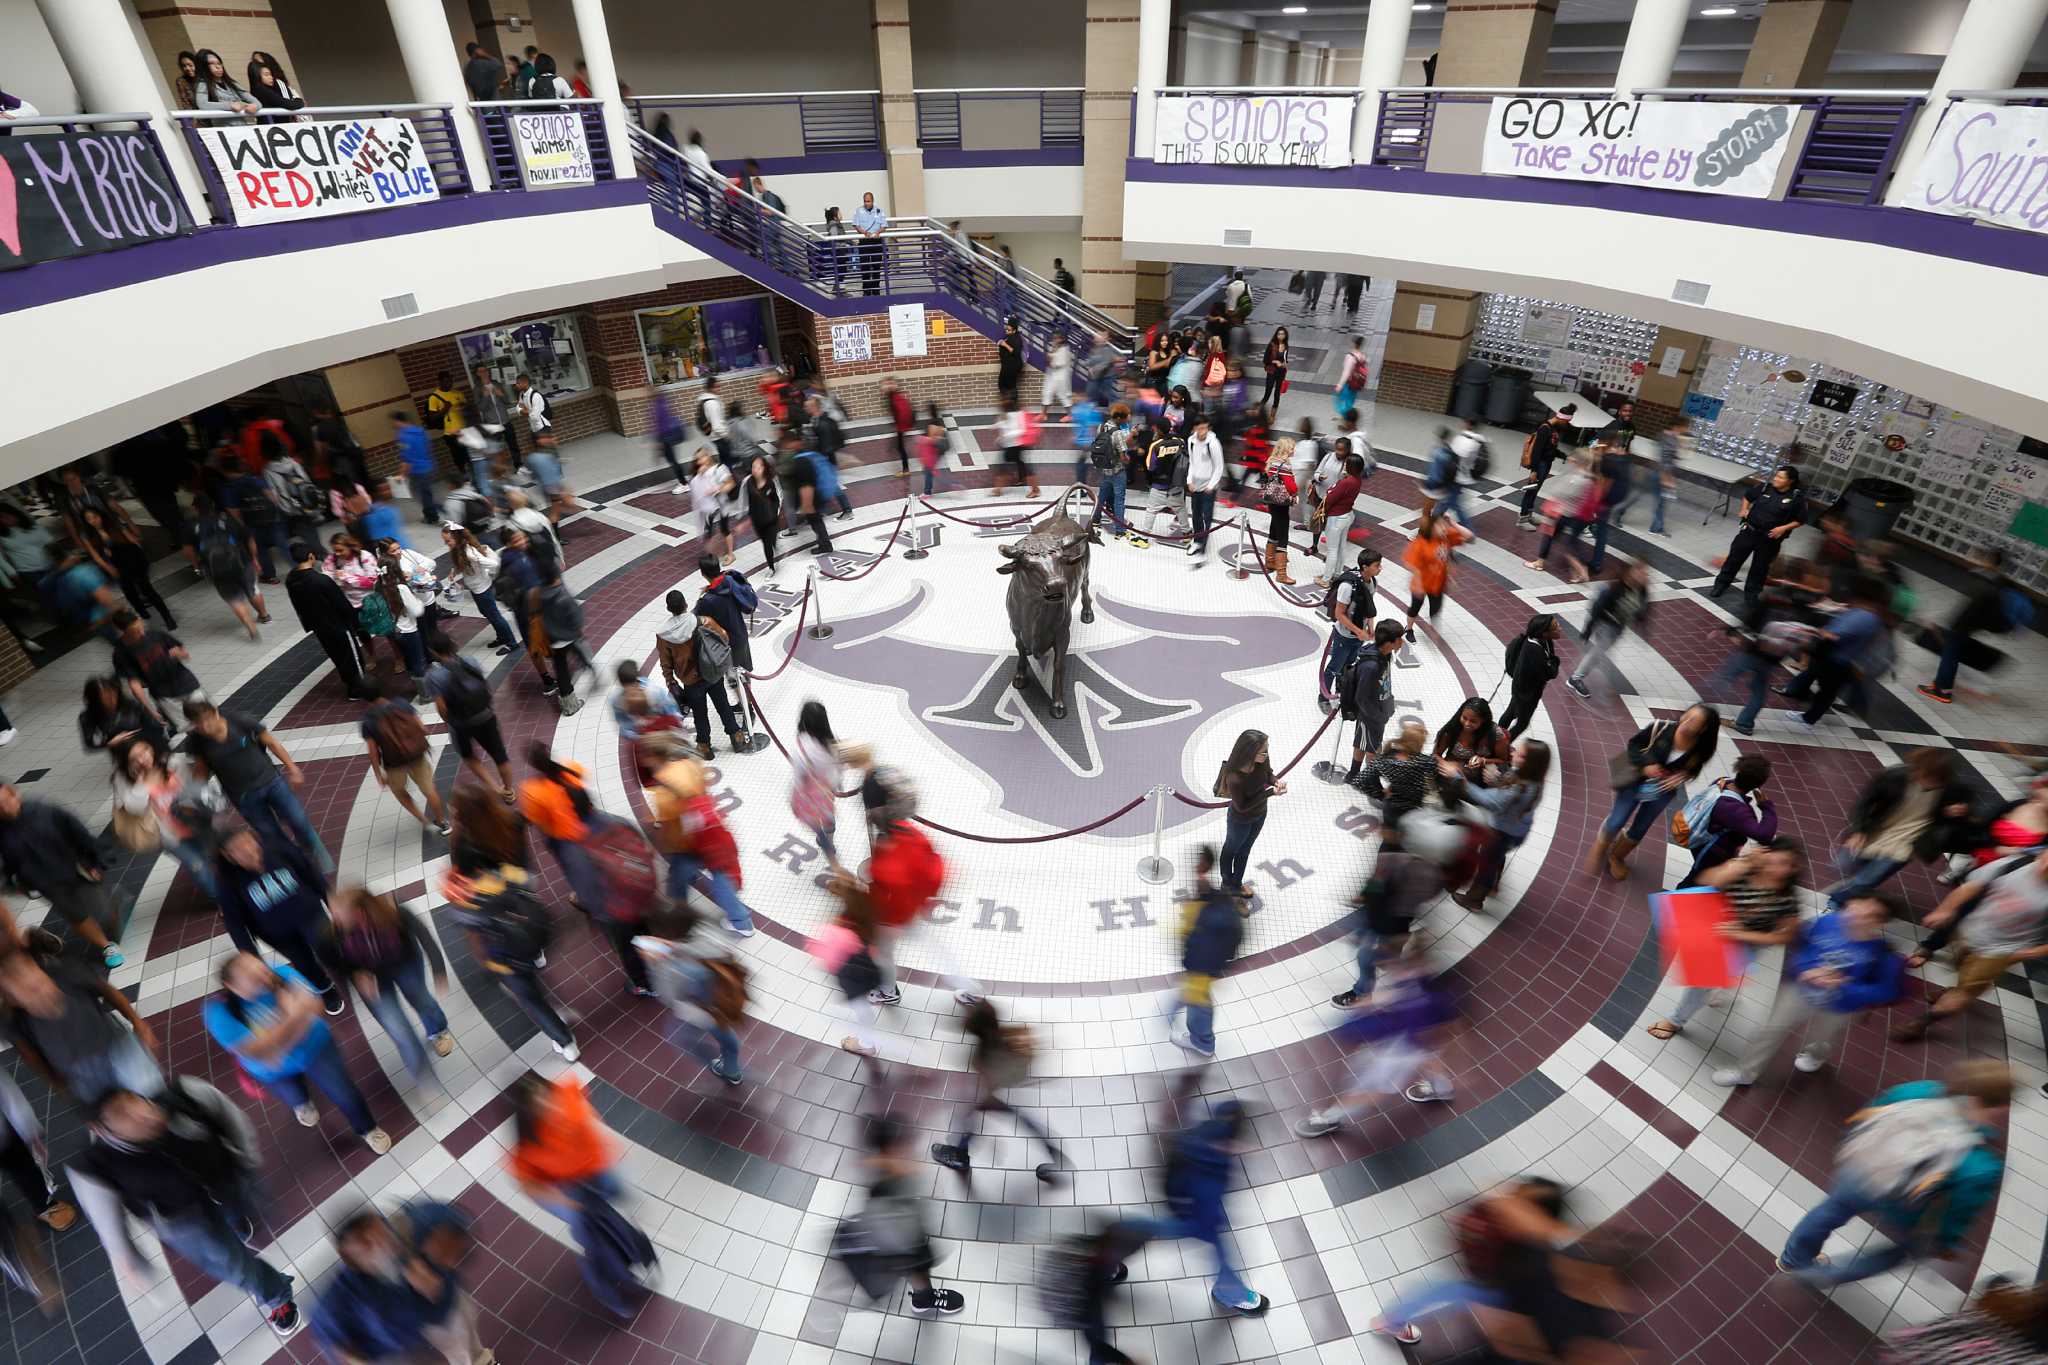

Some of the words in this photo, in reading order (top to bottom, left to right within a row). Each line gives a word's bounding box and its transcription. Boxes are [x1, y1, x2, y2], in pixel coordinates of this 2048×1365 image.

[388, 123, 414, 173] DAY
[1501, 99, 1564, 139] GO
[1579, 101, 1641, 139] XC!
[1581, 142, 1660, 180] State
[1662, 148, 1693, 182] by
[1705, 114, 1778, 176] STORM
[1215, 141, 1230, 164] IS
[1234, 143, 1268, 165] OUR
[1926, 112, 2048, 229] Savin
[23, 135, 178, 247] MRHS
[373, 167, 433, 204] BLUE
[762, 833, 1023, 932] Rch
